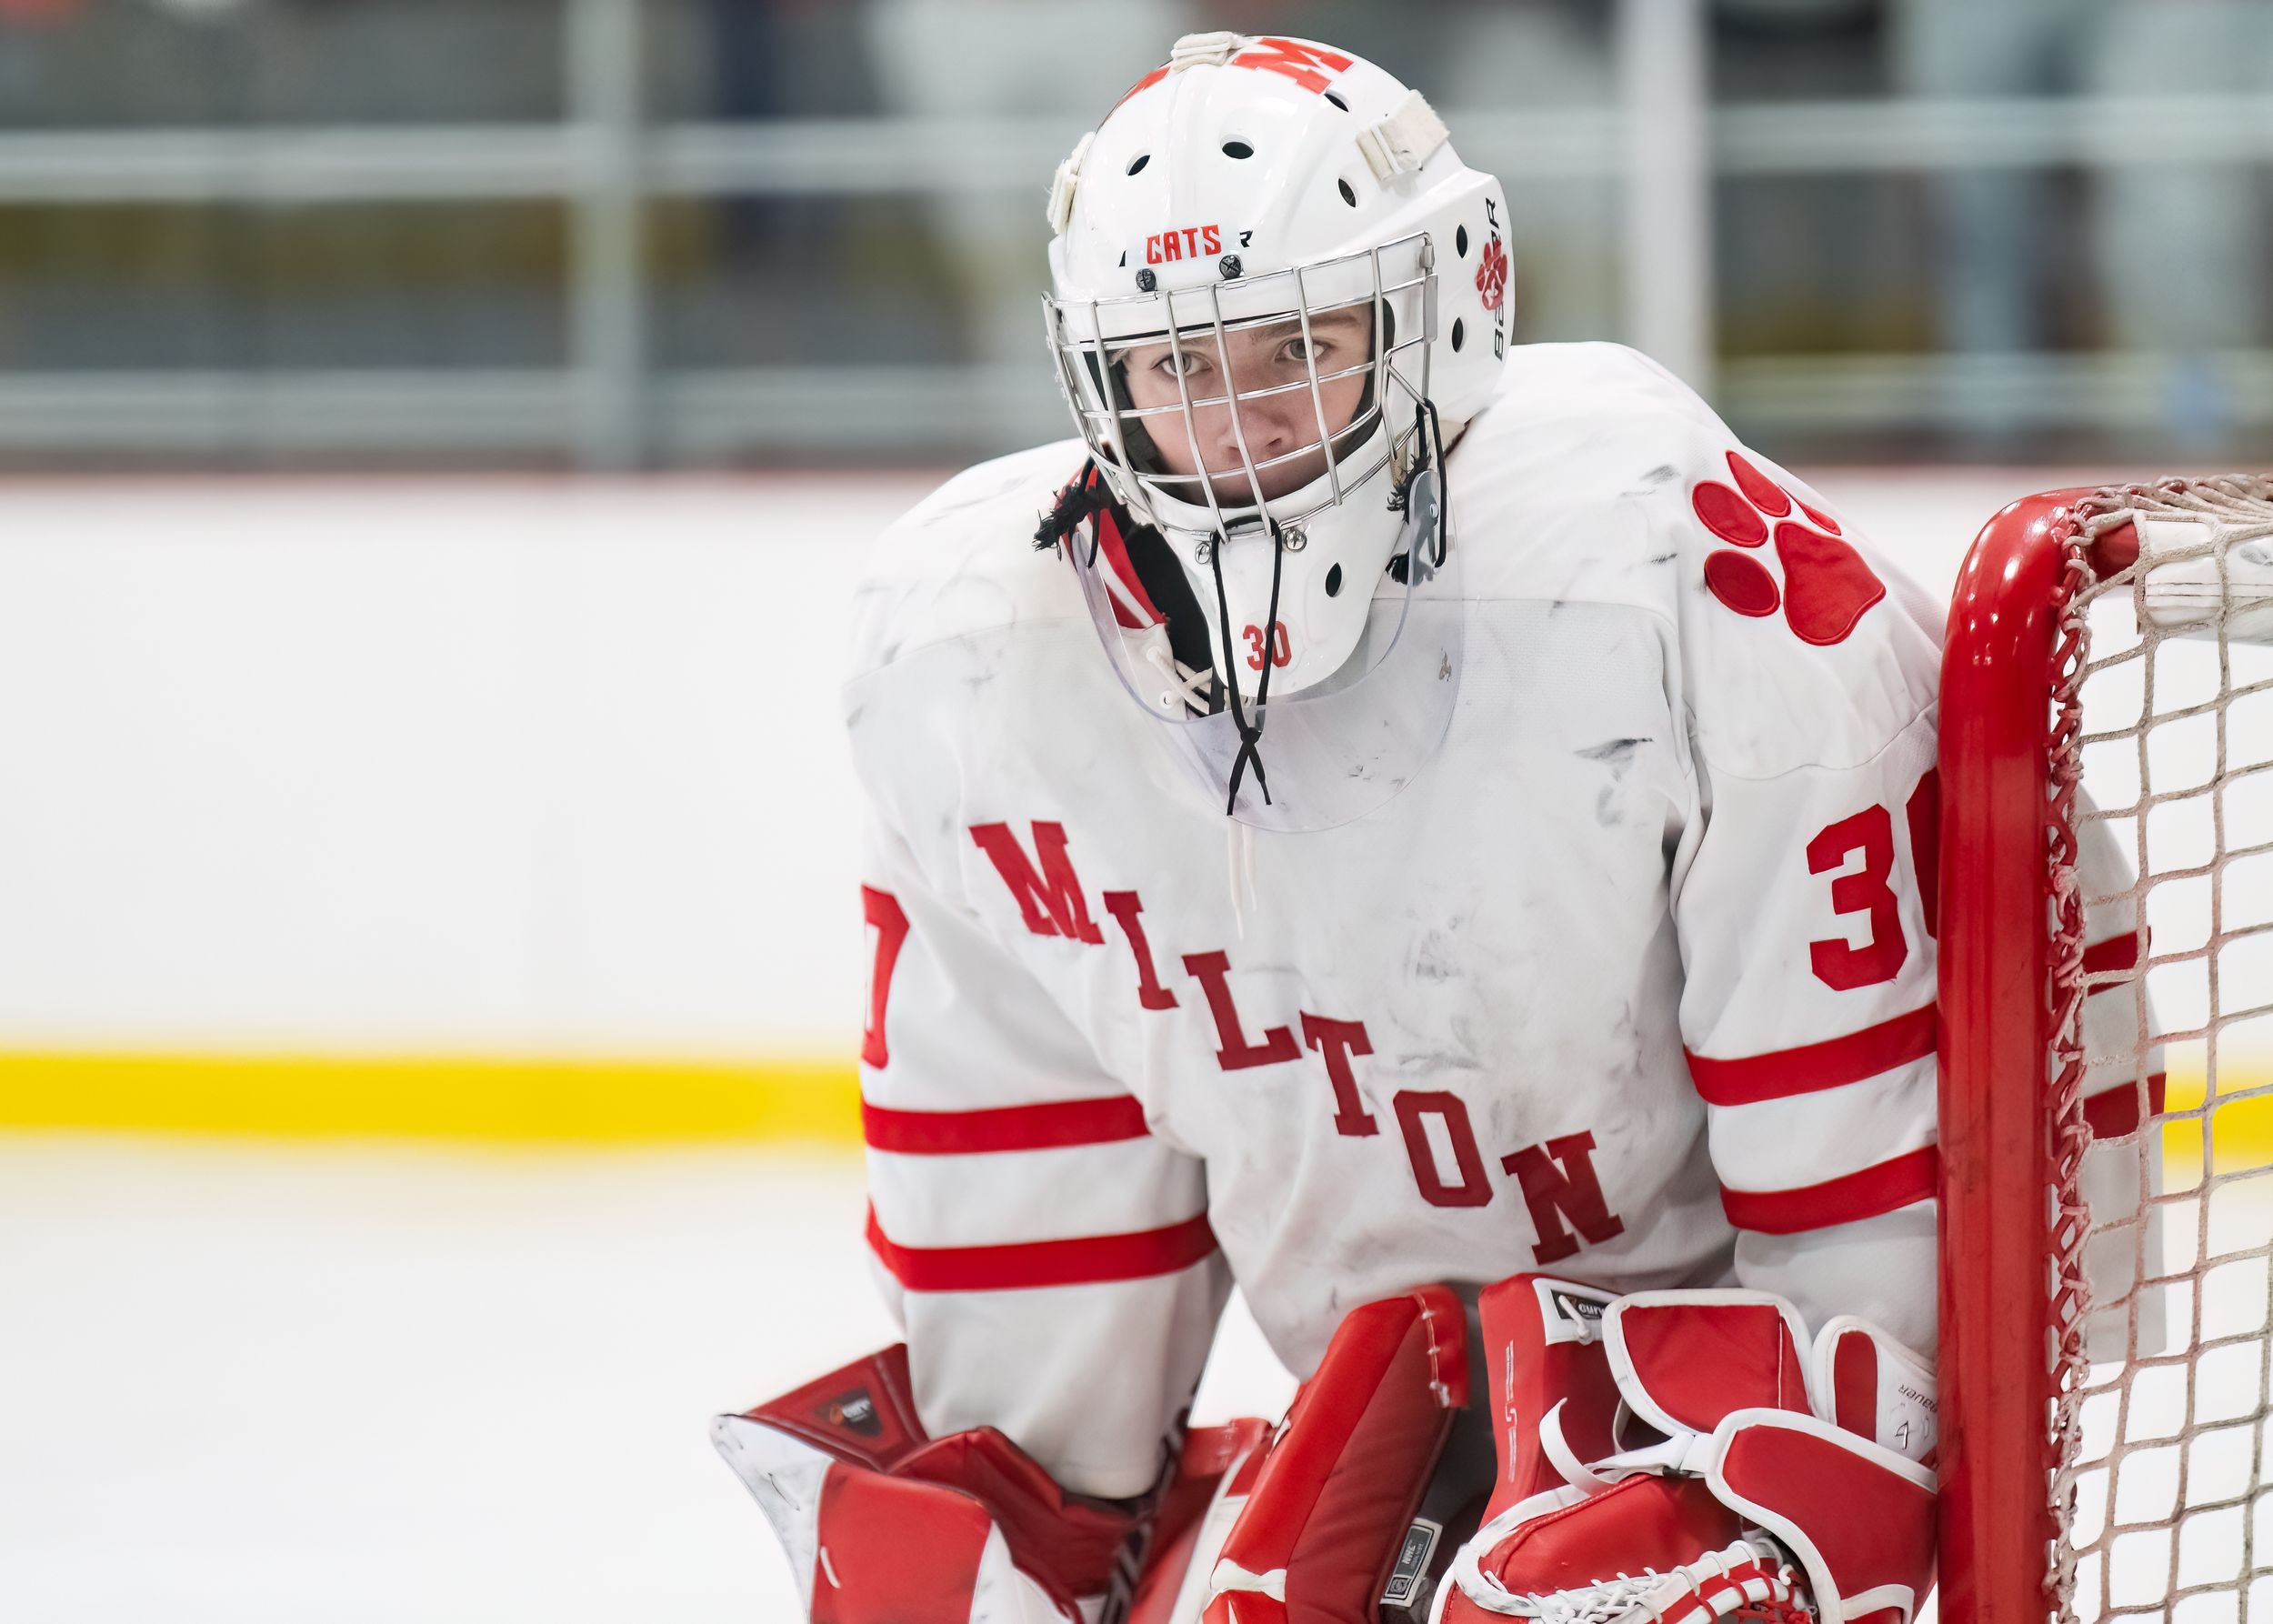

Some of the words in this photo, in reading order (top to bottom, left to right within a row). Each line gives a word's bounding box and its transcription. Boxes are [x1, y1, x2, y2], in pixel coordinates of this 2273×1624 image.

[1147, 225, 1222, 265] CATS
[1243, 621, 1292, 671] 30
[968, 820, 1625, 1265] MILTON
